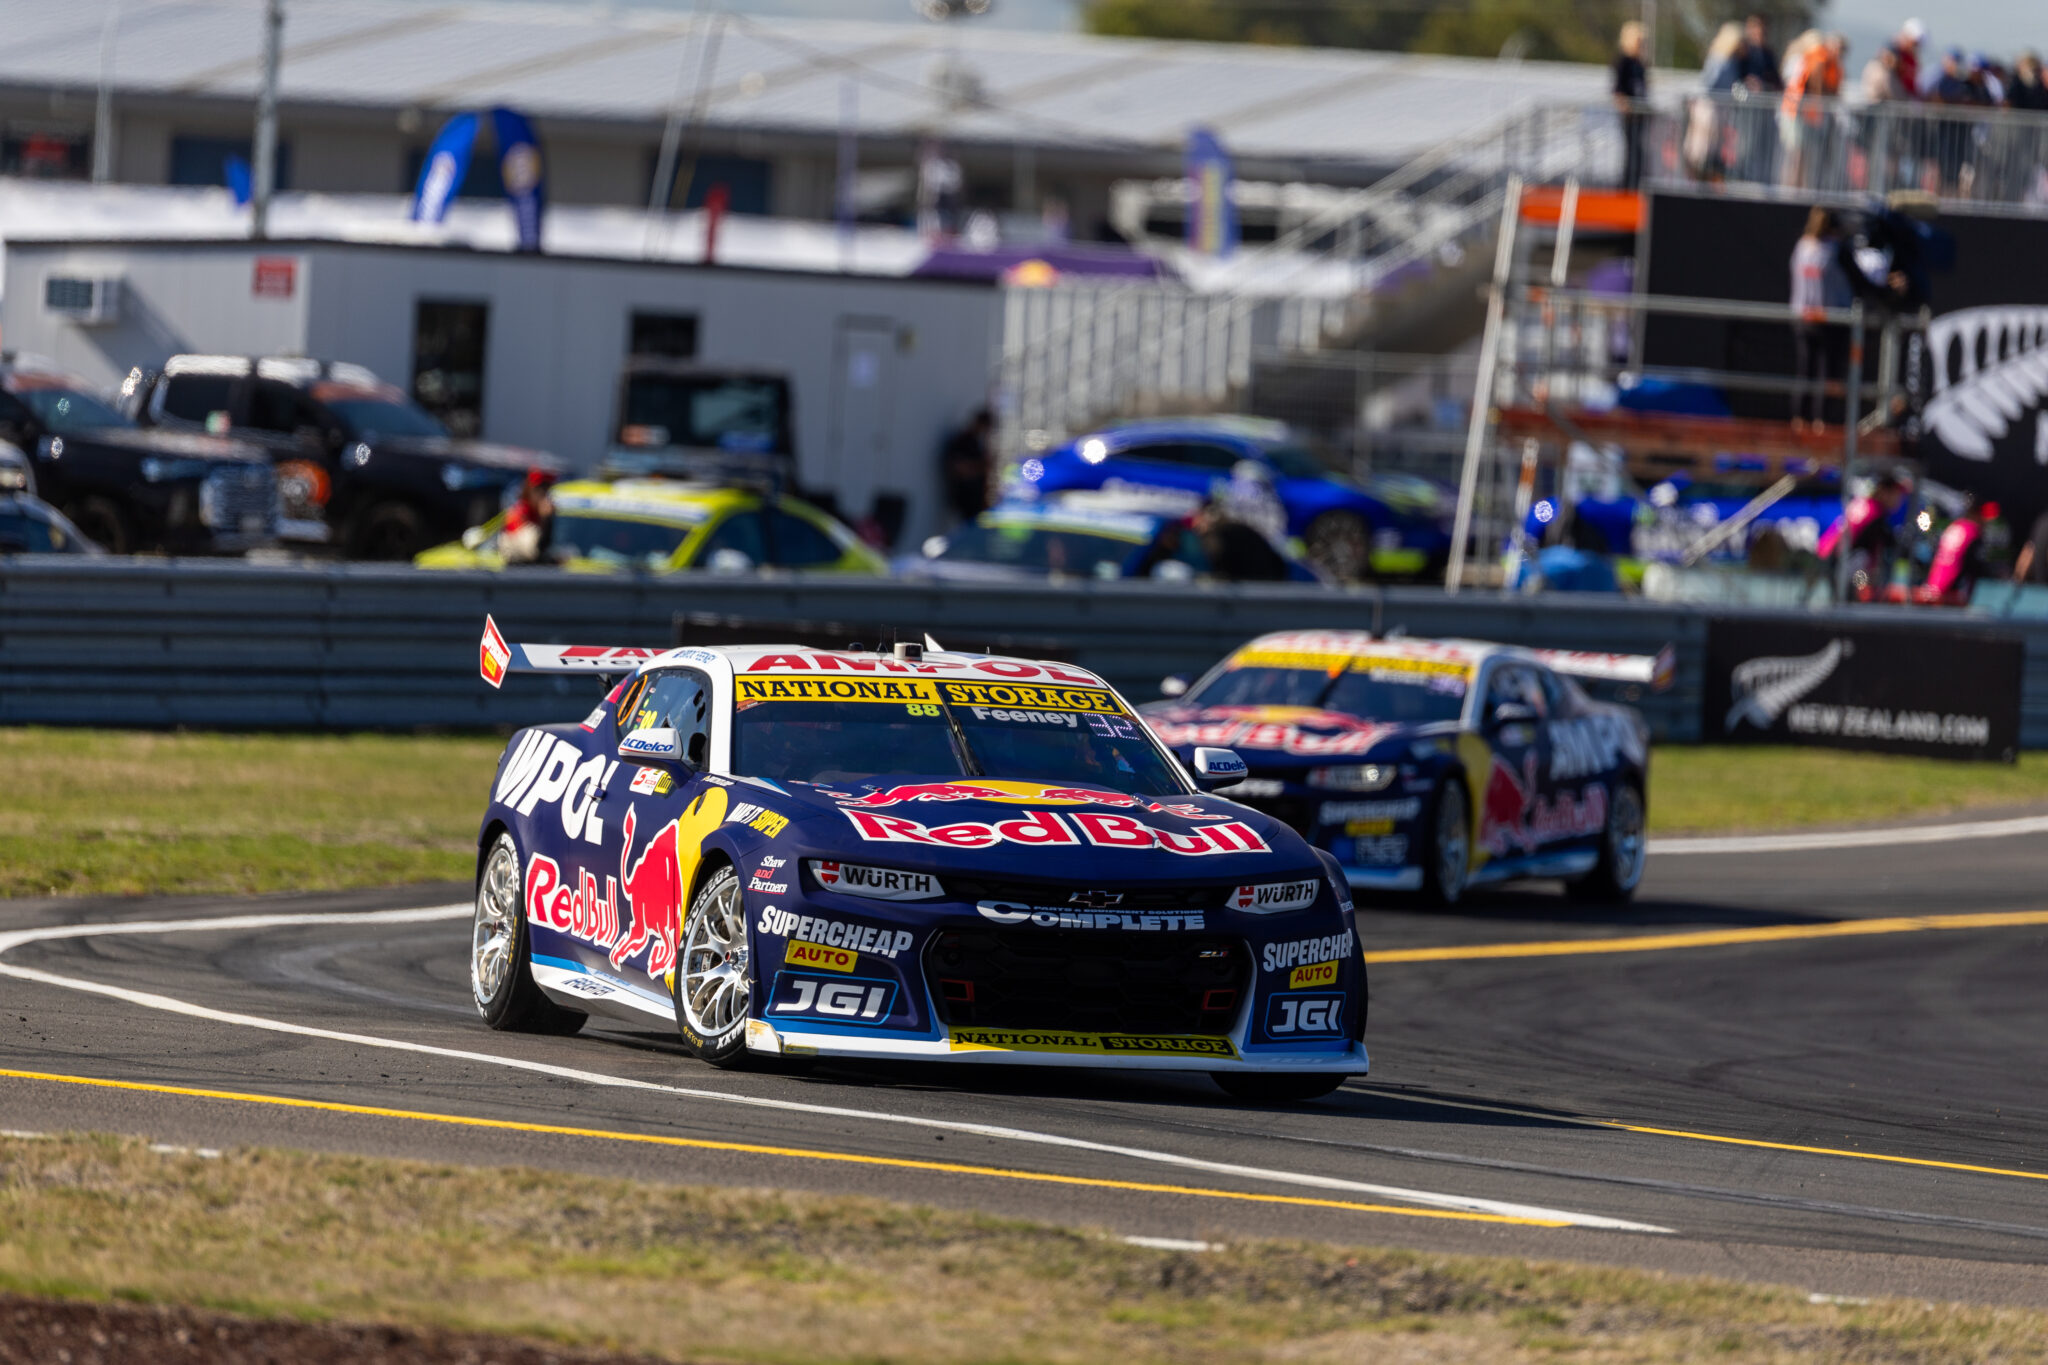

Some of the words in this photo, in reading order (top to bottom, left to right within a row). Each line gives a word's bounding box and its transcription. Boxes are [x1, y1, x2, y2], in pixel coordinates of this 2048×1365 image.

[738, 679, 931, 700] NATIONAL
[949, 684, 1114, 711] STORAGE
[906, 703, 940, 717] 88
[971, 706, 1078, 728] Feeney
[622, 737, 674, 753] ACDelco
[1209, 760, 1246, 771] ACDelc
[748, 809, 790, 839] SUPER
[838, 807, 1081, 849] Red
[1068, 812, 1273, 856] Bull
[761, 855, 787, 868] Shaw
[754, 868, 775, 879] and
[747, 877, 788, 893] Partners
[525, 851, 586, 938] Red
[580, 871, 620, 949] Bull
[976, 900, 1206, 931] COMPLETE
[757, 905, 914, 959] SUPERCHEAP
[793, 946, 849, 966] AUTO
[1263, 928, 1354, 973] SUPERCHEP
[1295, 966, 1333, 983] AUTO
[775, 980, 886, 1018] JGI
[1272, 1000, 1341, 1033] JGI
[955, 1032, 1098, 1047] NATIONAL
[1111, 1037, 1229, 1053] STORAGE
